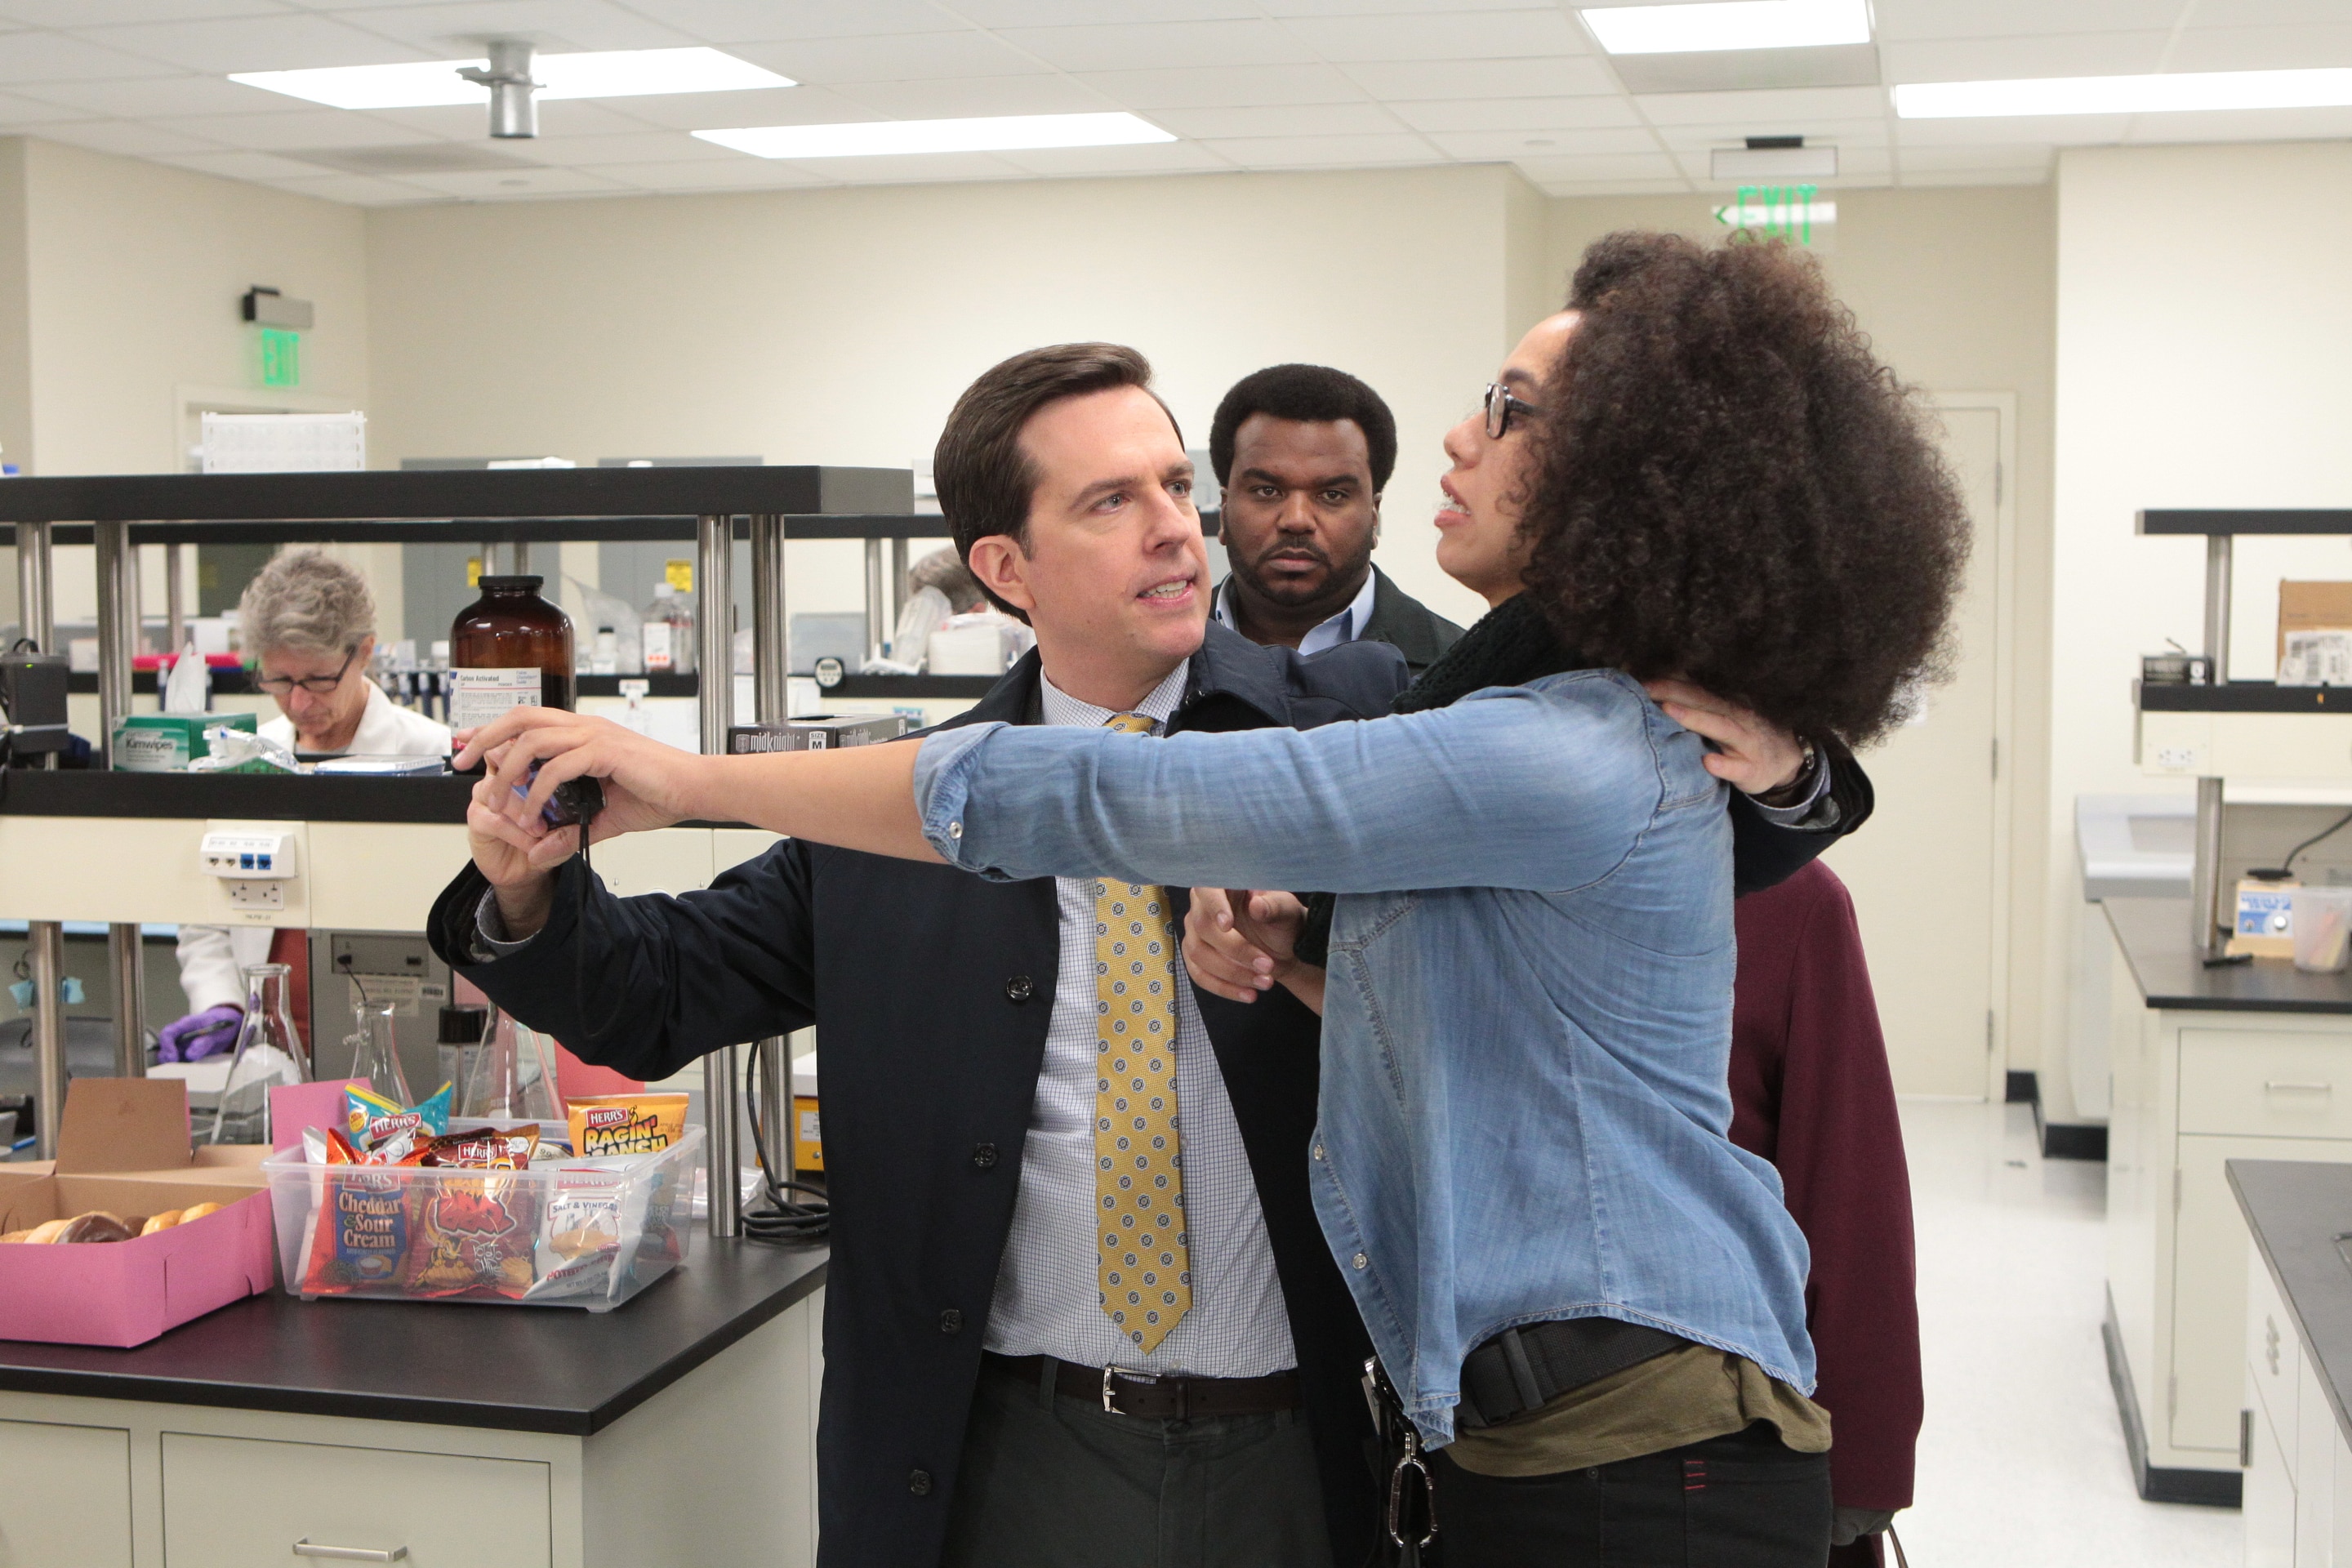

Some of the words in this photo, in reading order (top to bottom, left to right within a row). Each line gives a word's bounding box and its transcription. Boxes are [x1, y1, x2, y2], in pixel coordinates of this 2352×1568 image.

[1737, 184, 1818, 245] EXIT
[126, 737, 174, 752] Kimwipes
[812, 740, 822, 750] M
[375, 1115, 416, 1134] HERR'S
[590, 1109, 623, 1125] HERR'S
[583, 1115, 657, 1154] RAGIN'
[463, 1146, 495, 1159] HRRS
[338, 1192, 402, 1215] Cheddar
[553, 1202, 571, 1214] SALT
[573, 1201, 581, 1209] &
[354, 1214, 394, 1233] Sour
[343, 1229, 396, 1248] Cream
